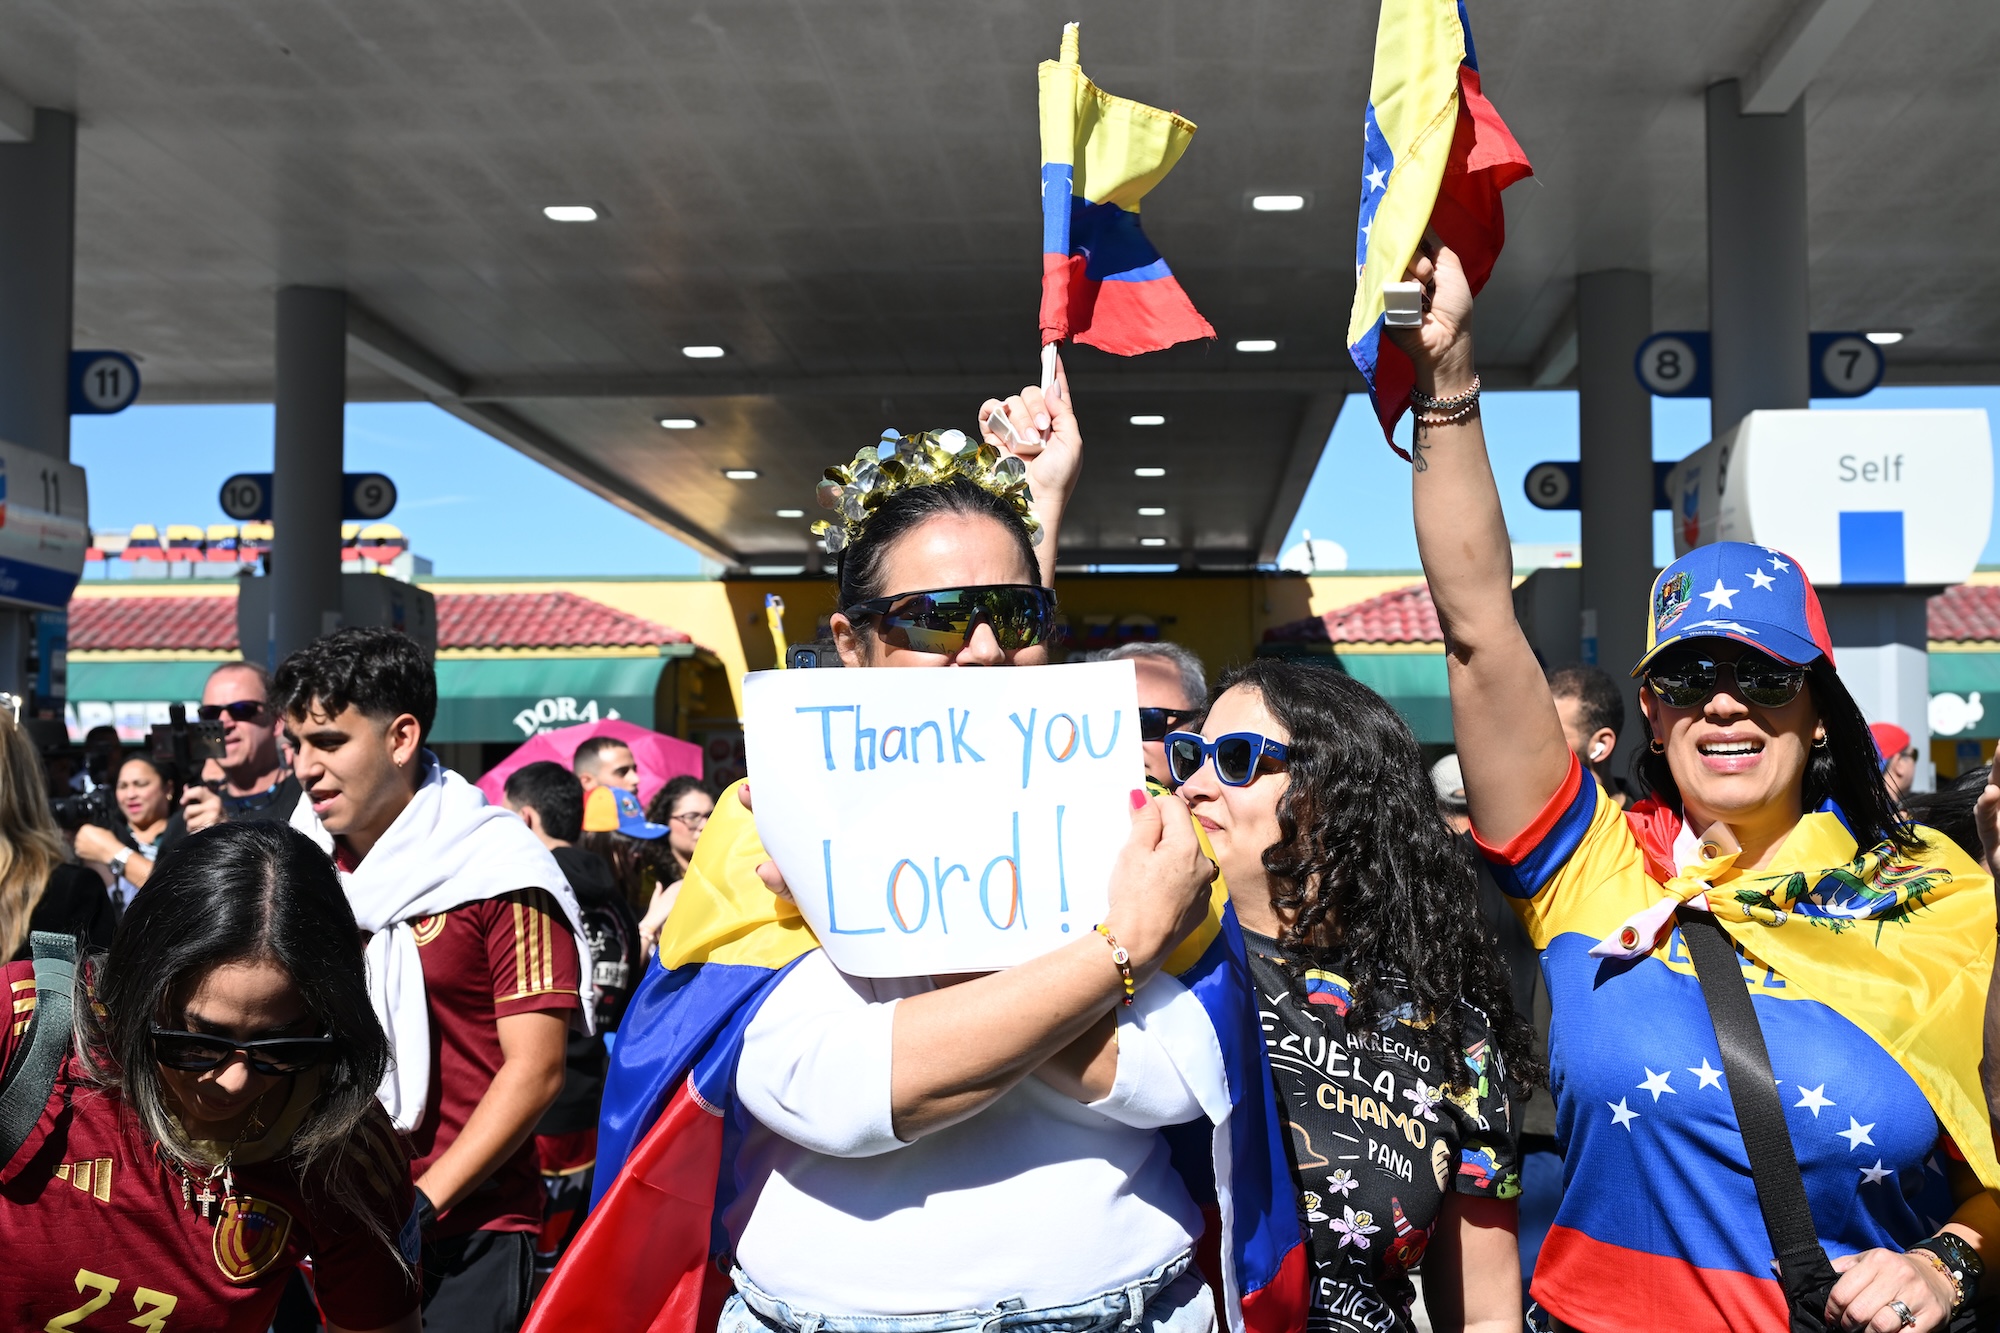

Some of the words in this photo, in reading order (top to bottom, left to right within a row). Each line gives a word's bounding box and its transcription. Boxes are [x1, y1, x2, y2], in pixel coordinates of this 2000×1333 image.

[1656, 350, 1681, 380] 8
[1838, 350, 1861, 379] 7
[95, 367, 119, 397] 11
[1839, 454, 1903, 482] Self
[40, 468, 60, 516] 11
[229, 485, 256, 508] 10
[365, 484, 382, 507] 9
[1540, 473, 1558, 498] 6
[795, 705, 985, 772] Thank
[1008, 707, 1121, 789] you
[822, 804, 1071, 934] Lord!
[1346, 1031, 1431, 1074] ARRECHO
[1316, 1083, 1427, 1150] CHAMO
[1368, 1138, 1413, 1183] PANA
